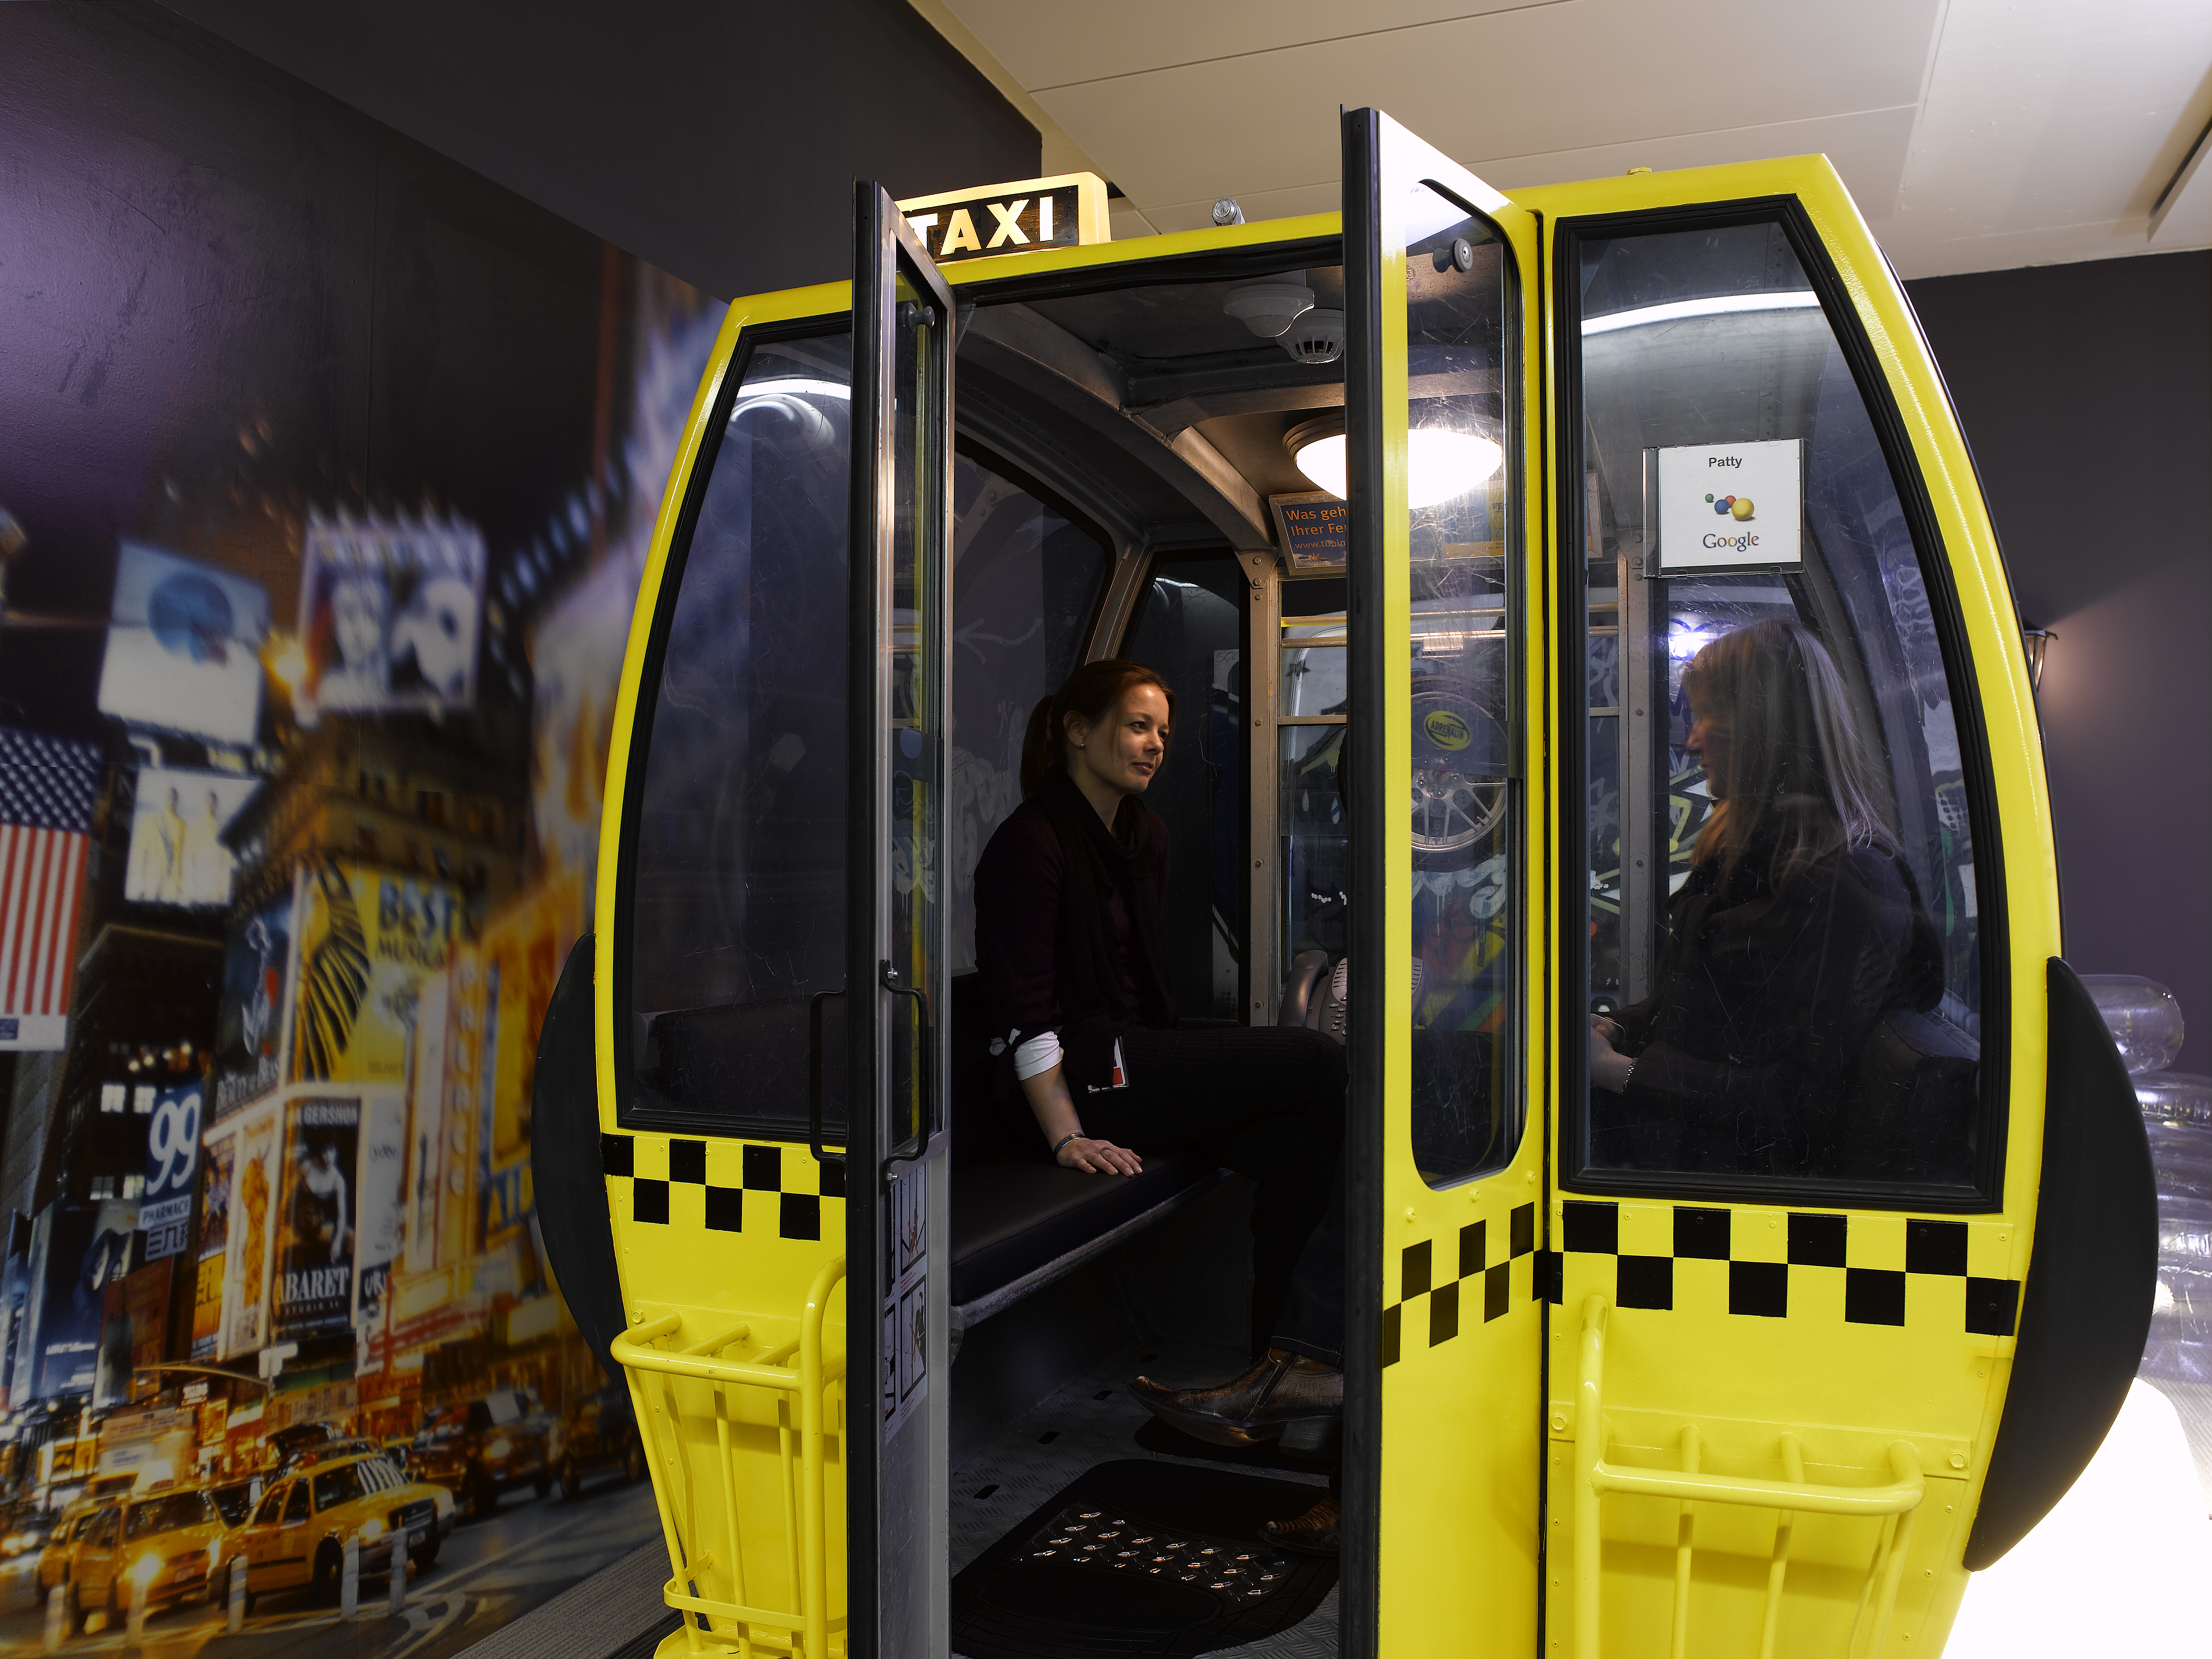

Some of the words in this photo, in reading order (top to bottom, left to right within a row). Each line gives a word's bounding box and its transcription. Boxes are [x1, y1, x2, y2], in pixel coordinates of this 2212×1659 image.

[906, 196, 1054, 256] TAXI
[1708, 456, 1743, 469] Patty
[1286, 509, 1317, 521] Was
[1291, 525, 1324, 536] Ihrer
[1702, 531, 1759, 552] Google
[1430, 720, 1465, 740] ADRENALIN
[1433, 820, 1441, 830] 6
[146, 1093, 201, 1196] 99
